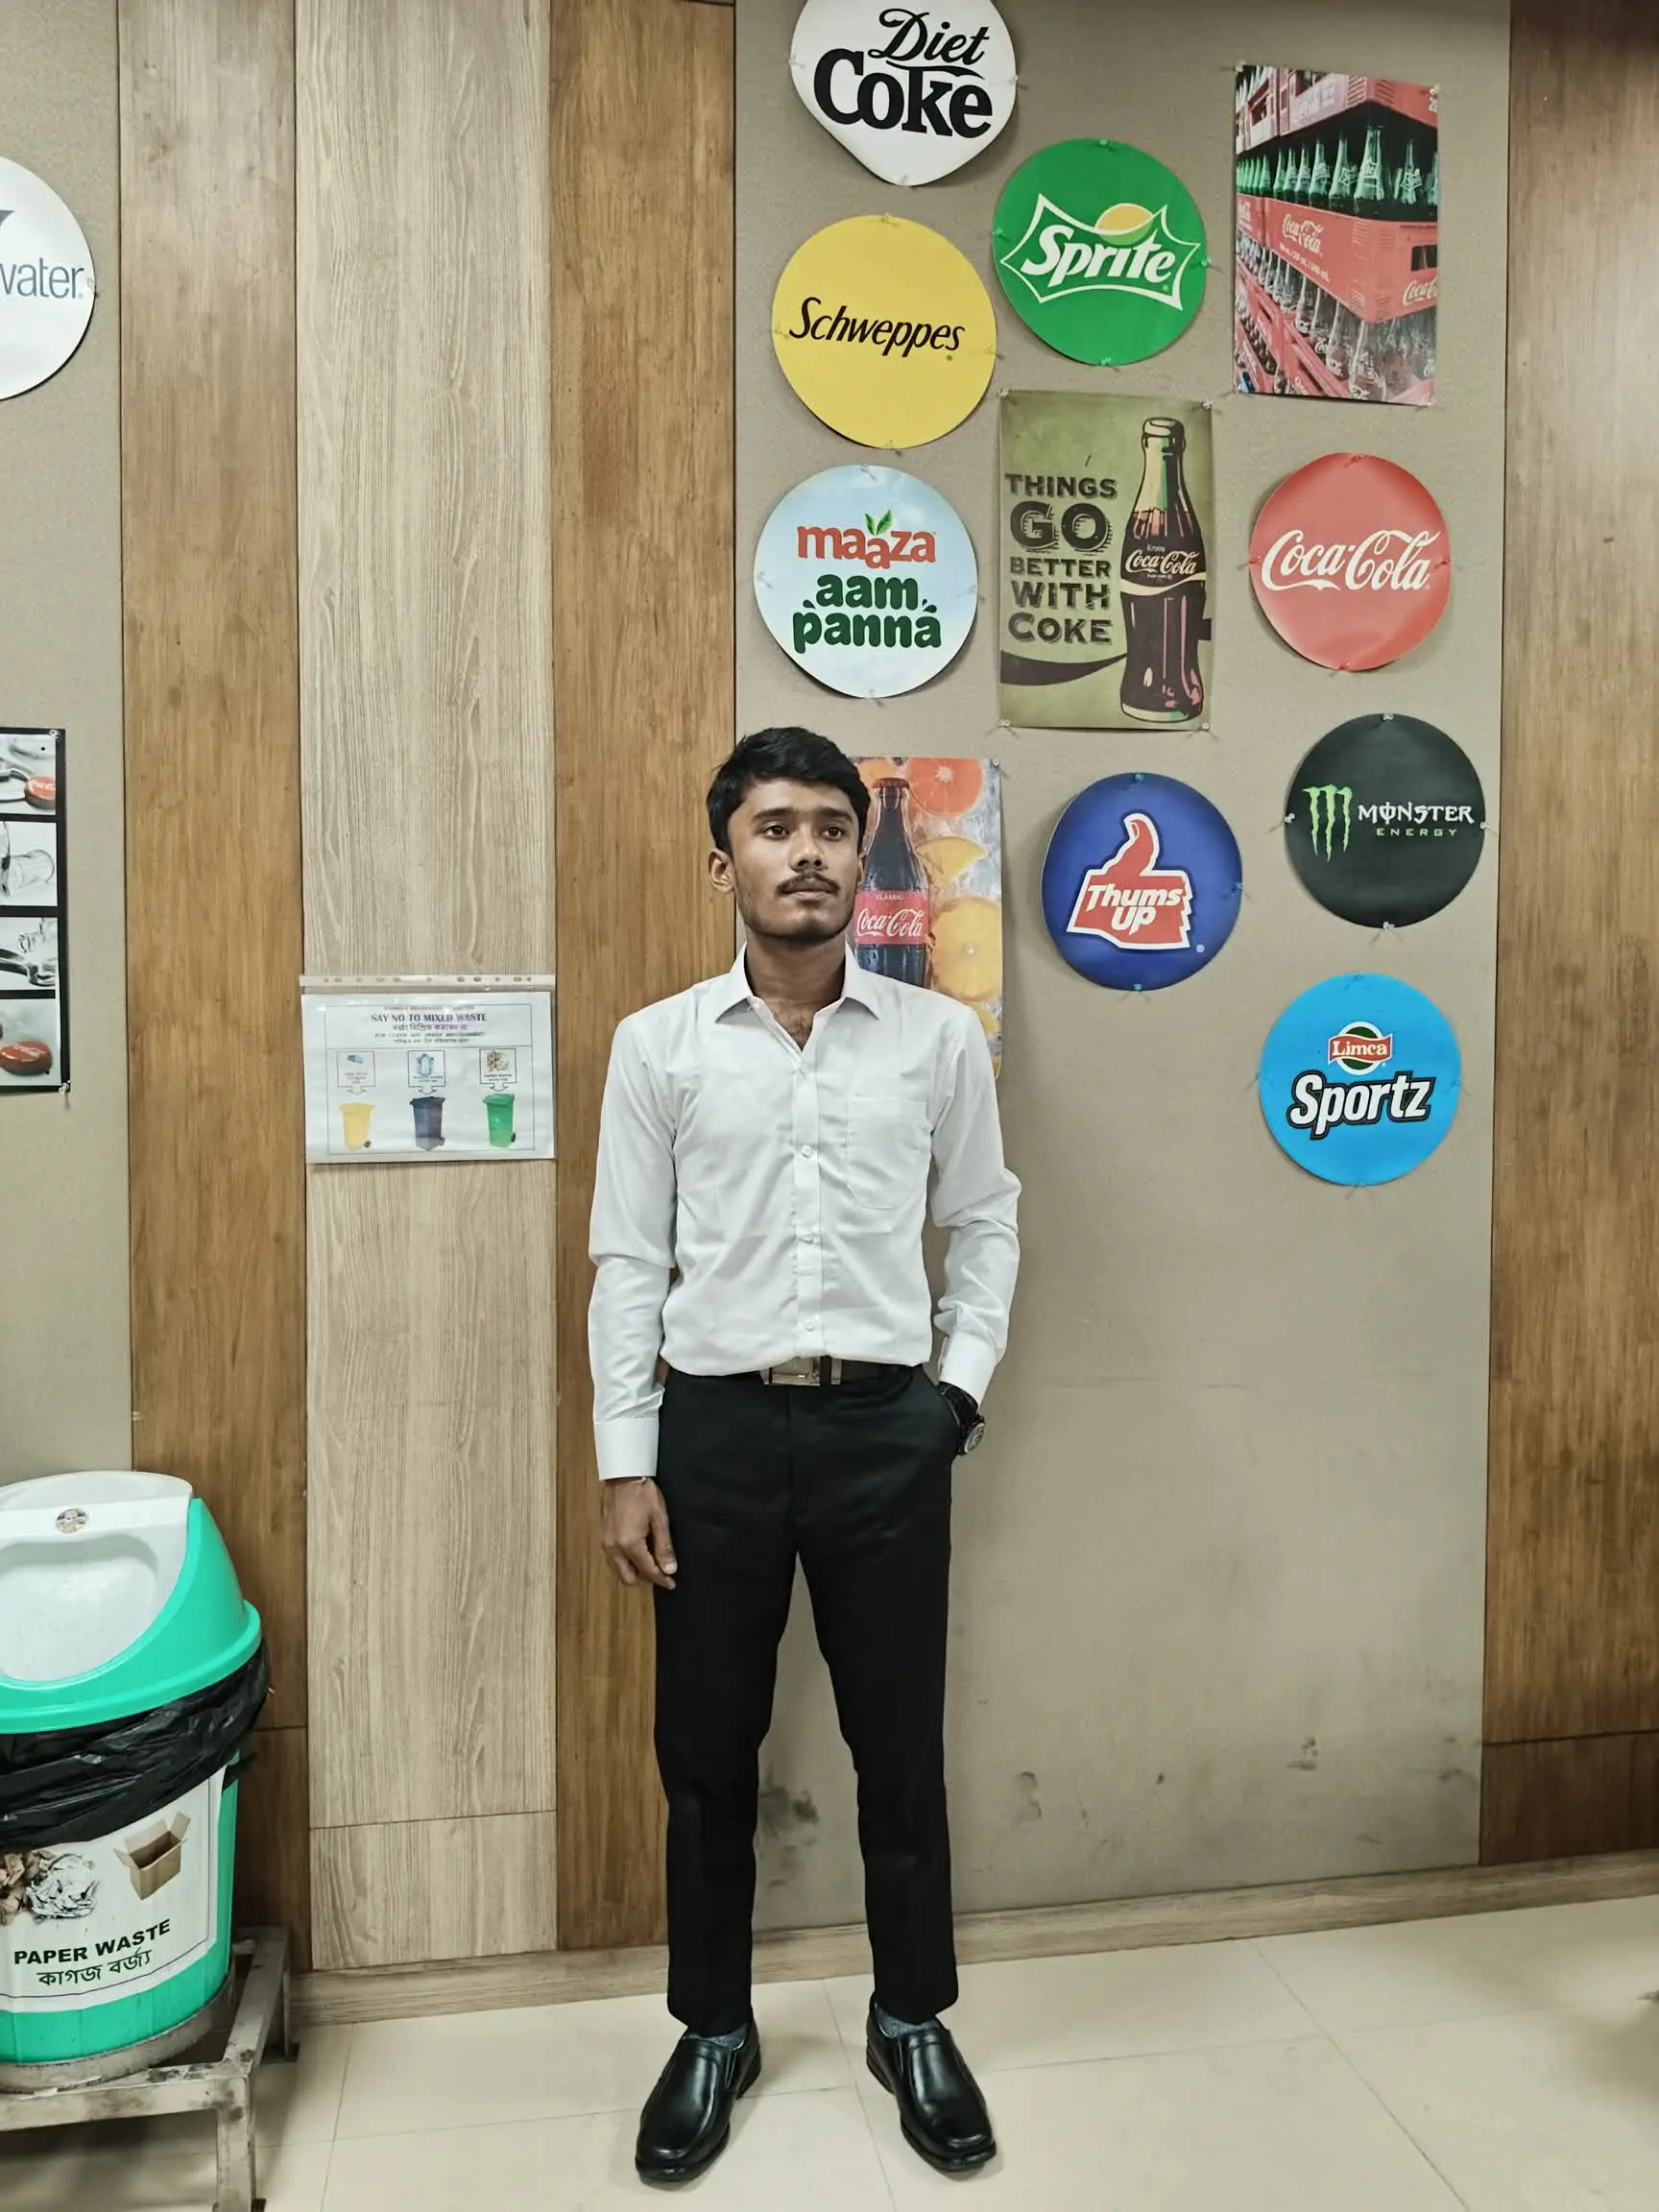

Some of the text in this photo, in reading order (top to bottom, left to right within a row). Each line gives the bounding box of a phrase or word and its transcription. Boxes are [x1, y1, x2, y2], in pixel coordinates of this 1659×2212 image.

[868, 8, 990, 65] Diet
[813, 48, 993, 138] Coke
[1020, 224, 1177, 288] Sprite
[788, 297, 965, 357] Schweppes
[1005, 473, 1118, 499] THINGS
[1010, 500, 1113, 554] GO
[797, 526, 936, 569] maaza
[1125, 549, 1200, 574] Coca-Cola
[1261, 529, 1442, 591] Coca-Cola
[1010, 556, 1111, 578] BETTER
[816, 574, 919, 611] aam
[1011, 581, 1111, 610] WITH
[792, 612, 942, 655] panna
[1009, 612, 1114, 645] COKE
[1358, 802, 1475, 825] MONSTER
[1376, 828, 1457, 836] ENERGY
[1086, 883, 1185, 912] Thums
[856, 908, 926, 937] Coca-Cola
[371, 1013, 487, 1022] SAY NO TO MIXED WASTE
[1332, 1040, 1388, 1057] Limca
[1287, 1070, 1434, 1139] Sportz
[14, 1918, 171, 1965] PAPER WASTE
[36, 1946, 153, 1986] কাগজ বর্জ্য
